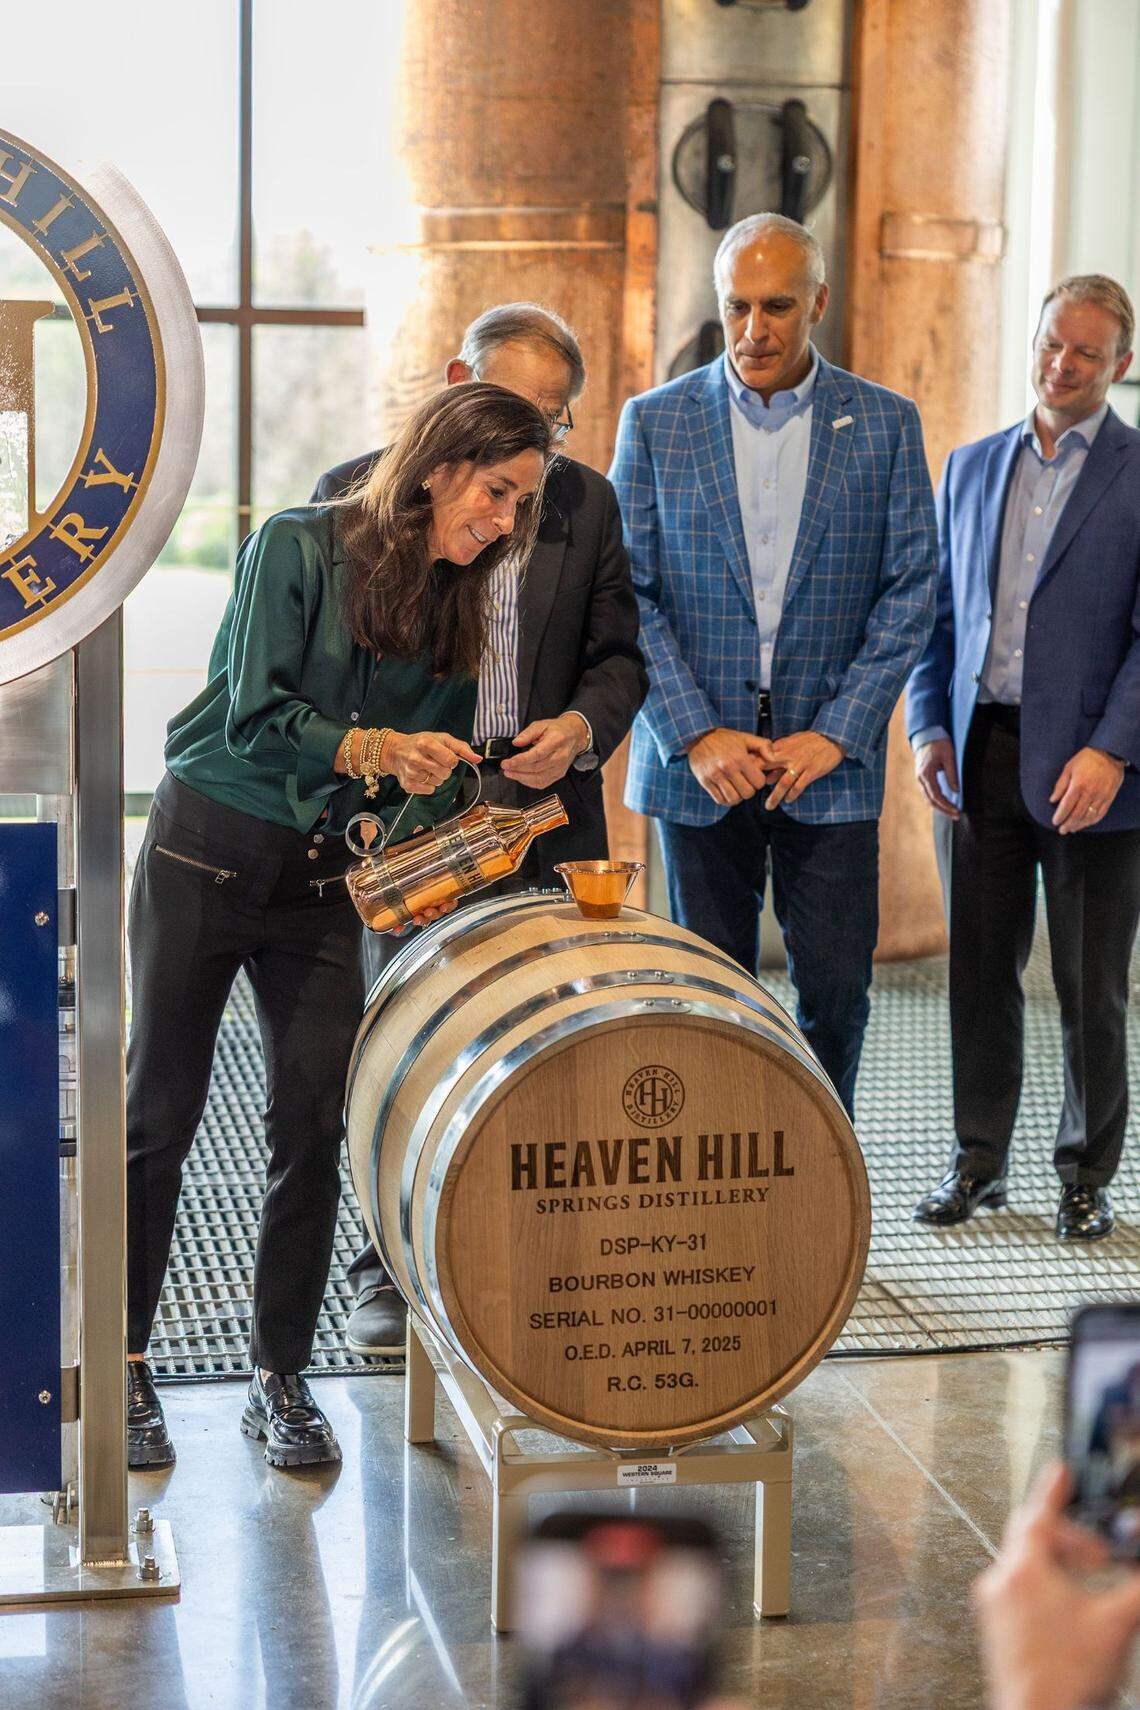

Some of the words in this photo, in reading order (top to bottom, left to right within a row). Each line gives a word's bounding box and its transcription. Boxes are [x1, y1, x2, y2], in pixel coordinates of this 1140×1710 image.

[625, 1068, 658, 1096] HEAVEN
[663, 1072, 681, 1094] HILL
[510, 1135, 683, 1191] HEAVEN
[697, 1130, 795, 1181] HILL
[535, 1194, 630, 1215] SPRINGS
[638, 1187, 770, 1209] DISTILLERY
[600, 1233, 706, 1256] DSP-KY-31
[549, 1271, 655, 1293] BOURBON
[663, 1265, 756, 1287] WHISKEY
[529, 1310, 604, 1329] SERIAL
[611, 1307, 646, 1325] NO.
[653, 1299, 777, 1322] 31-00000001
[564, 1343, 616, 1361] O.E.D.
[621, 1339, 676, 1358] APRIL
[681, 1338, 696, 1355] 7,
[701, 1335, 742, 1353] 2025
[607, 1375, 647, 1392] R.C.
[654, 1372, 699, 1390] 53G.
